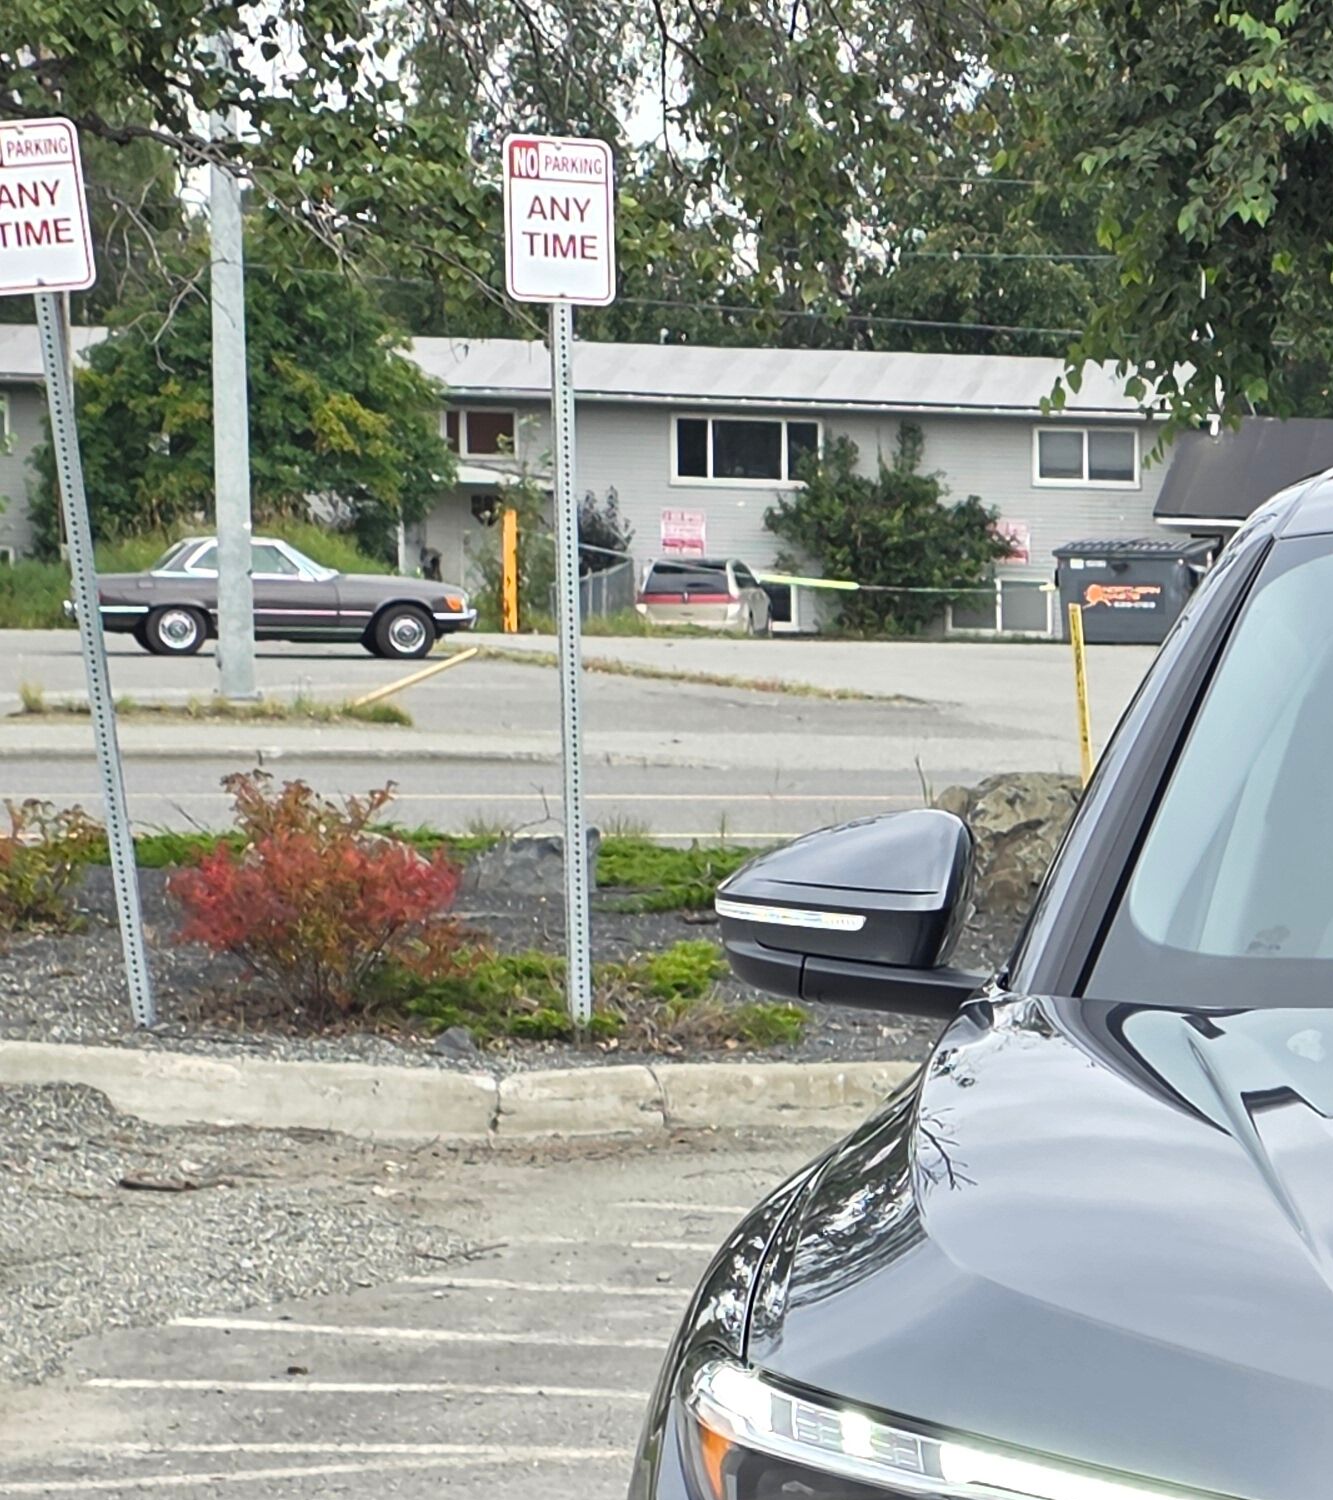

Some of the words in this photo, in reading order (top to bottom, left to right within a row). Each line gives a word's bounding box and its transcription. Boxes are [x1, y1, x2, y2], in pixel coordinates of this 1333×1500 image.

[6, 137, 68, 158] PARKING
[513, 146, 539, 178] NO
[545, 155, 602, 175] PARKING
[0, 179, 60, 209] ANY
[527, 194, 591, 223] ANY
[0, 218, 74, 248] TIME
[522, 231, 598, 260] TIME
